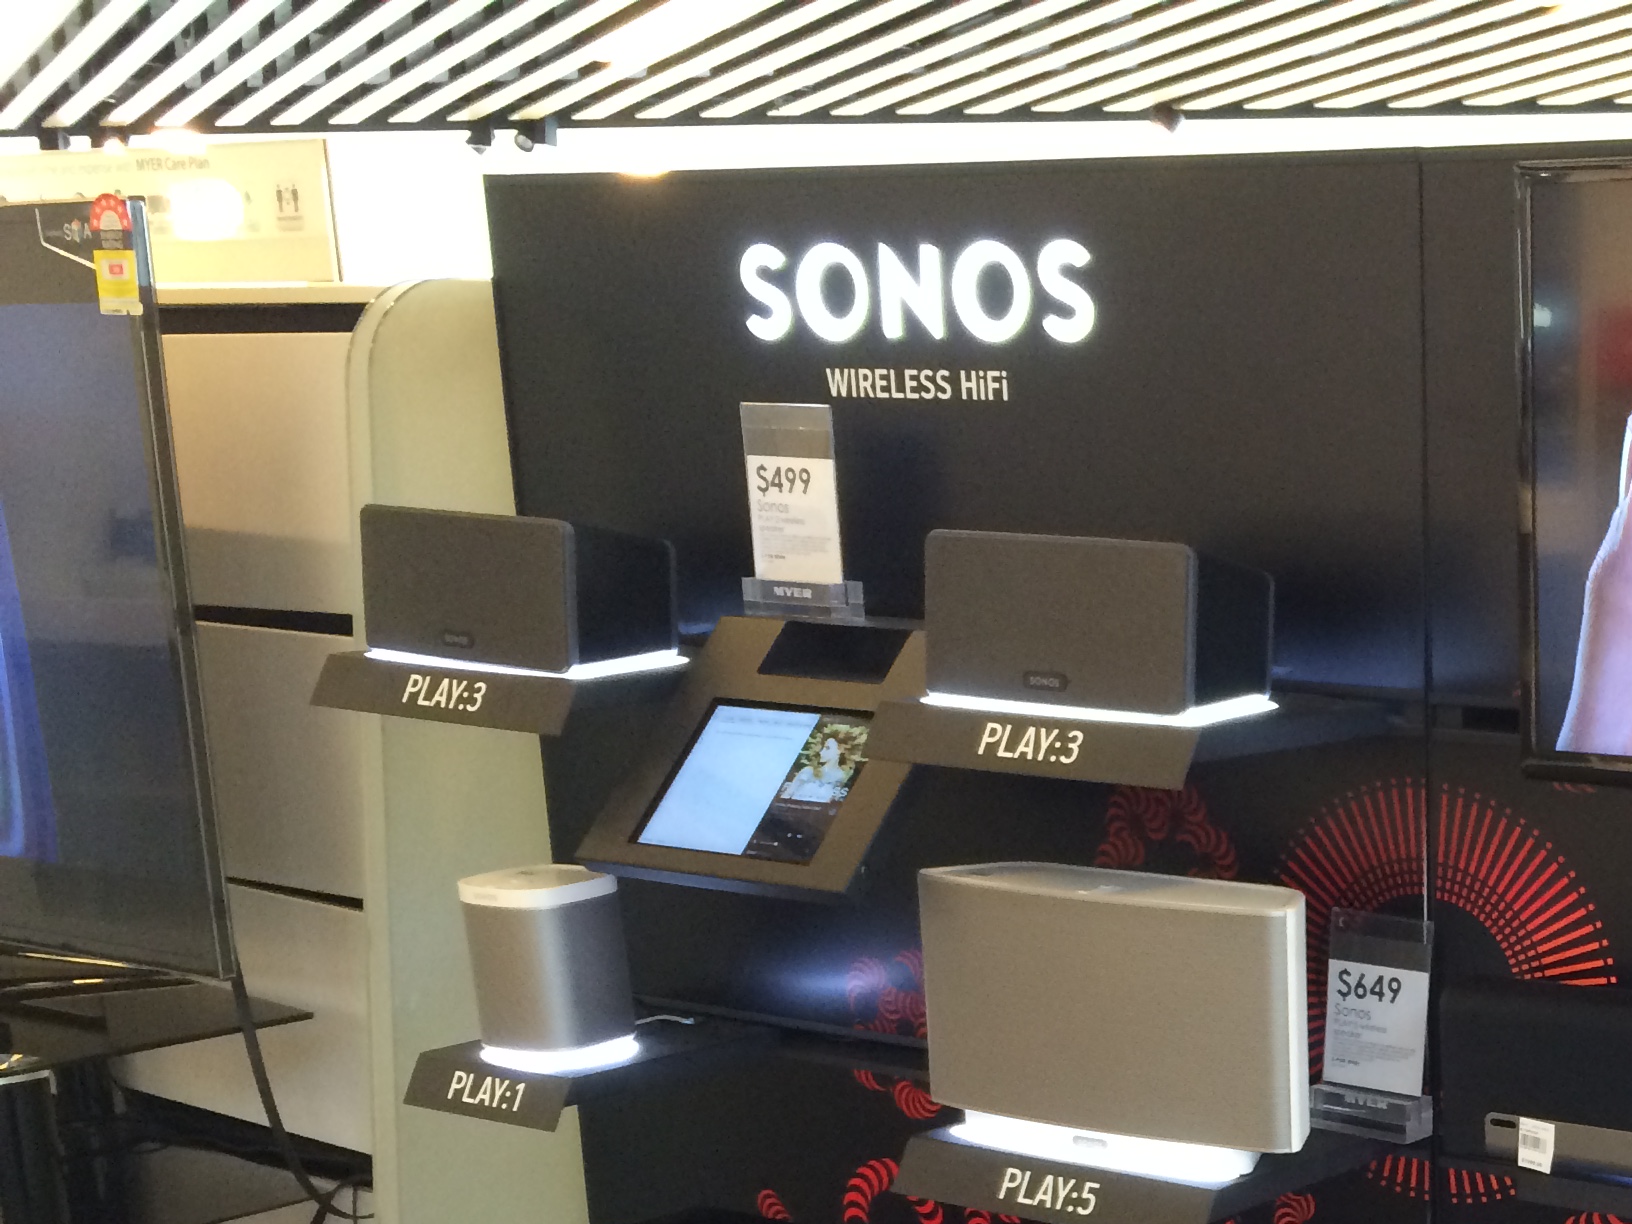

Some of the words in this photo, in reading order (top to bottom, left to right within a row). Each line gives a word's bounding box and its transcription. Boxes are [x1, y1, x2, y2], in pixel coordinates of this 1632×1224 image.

[136, 157, 163, 171] MYER
[165, 157, 187, 171] Care
[188, 156, 210, 170] Plan
[739, 239, 1096, 344] SONOS
[825, 367, 952, 400] WIRELESS
[960, 370, 1009, 401] HiFi
[756, 463, 812, 498] $499
[757, 499, 790, 514] Sonos
[772, 586, 813, 599] MYER
[402, 673, 488, 713] PLAY:3
[977, 722, 1084, 765] PLAY:3
[1336, 967, 1403, 1005] $649
[1333, 1002, 1373, 1021] Sonos
[446, 1070, 526, 1113] PLAY:1
[998, 1166, 1100, 1217] PLAY:5
